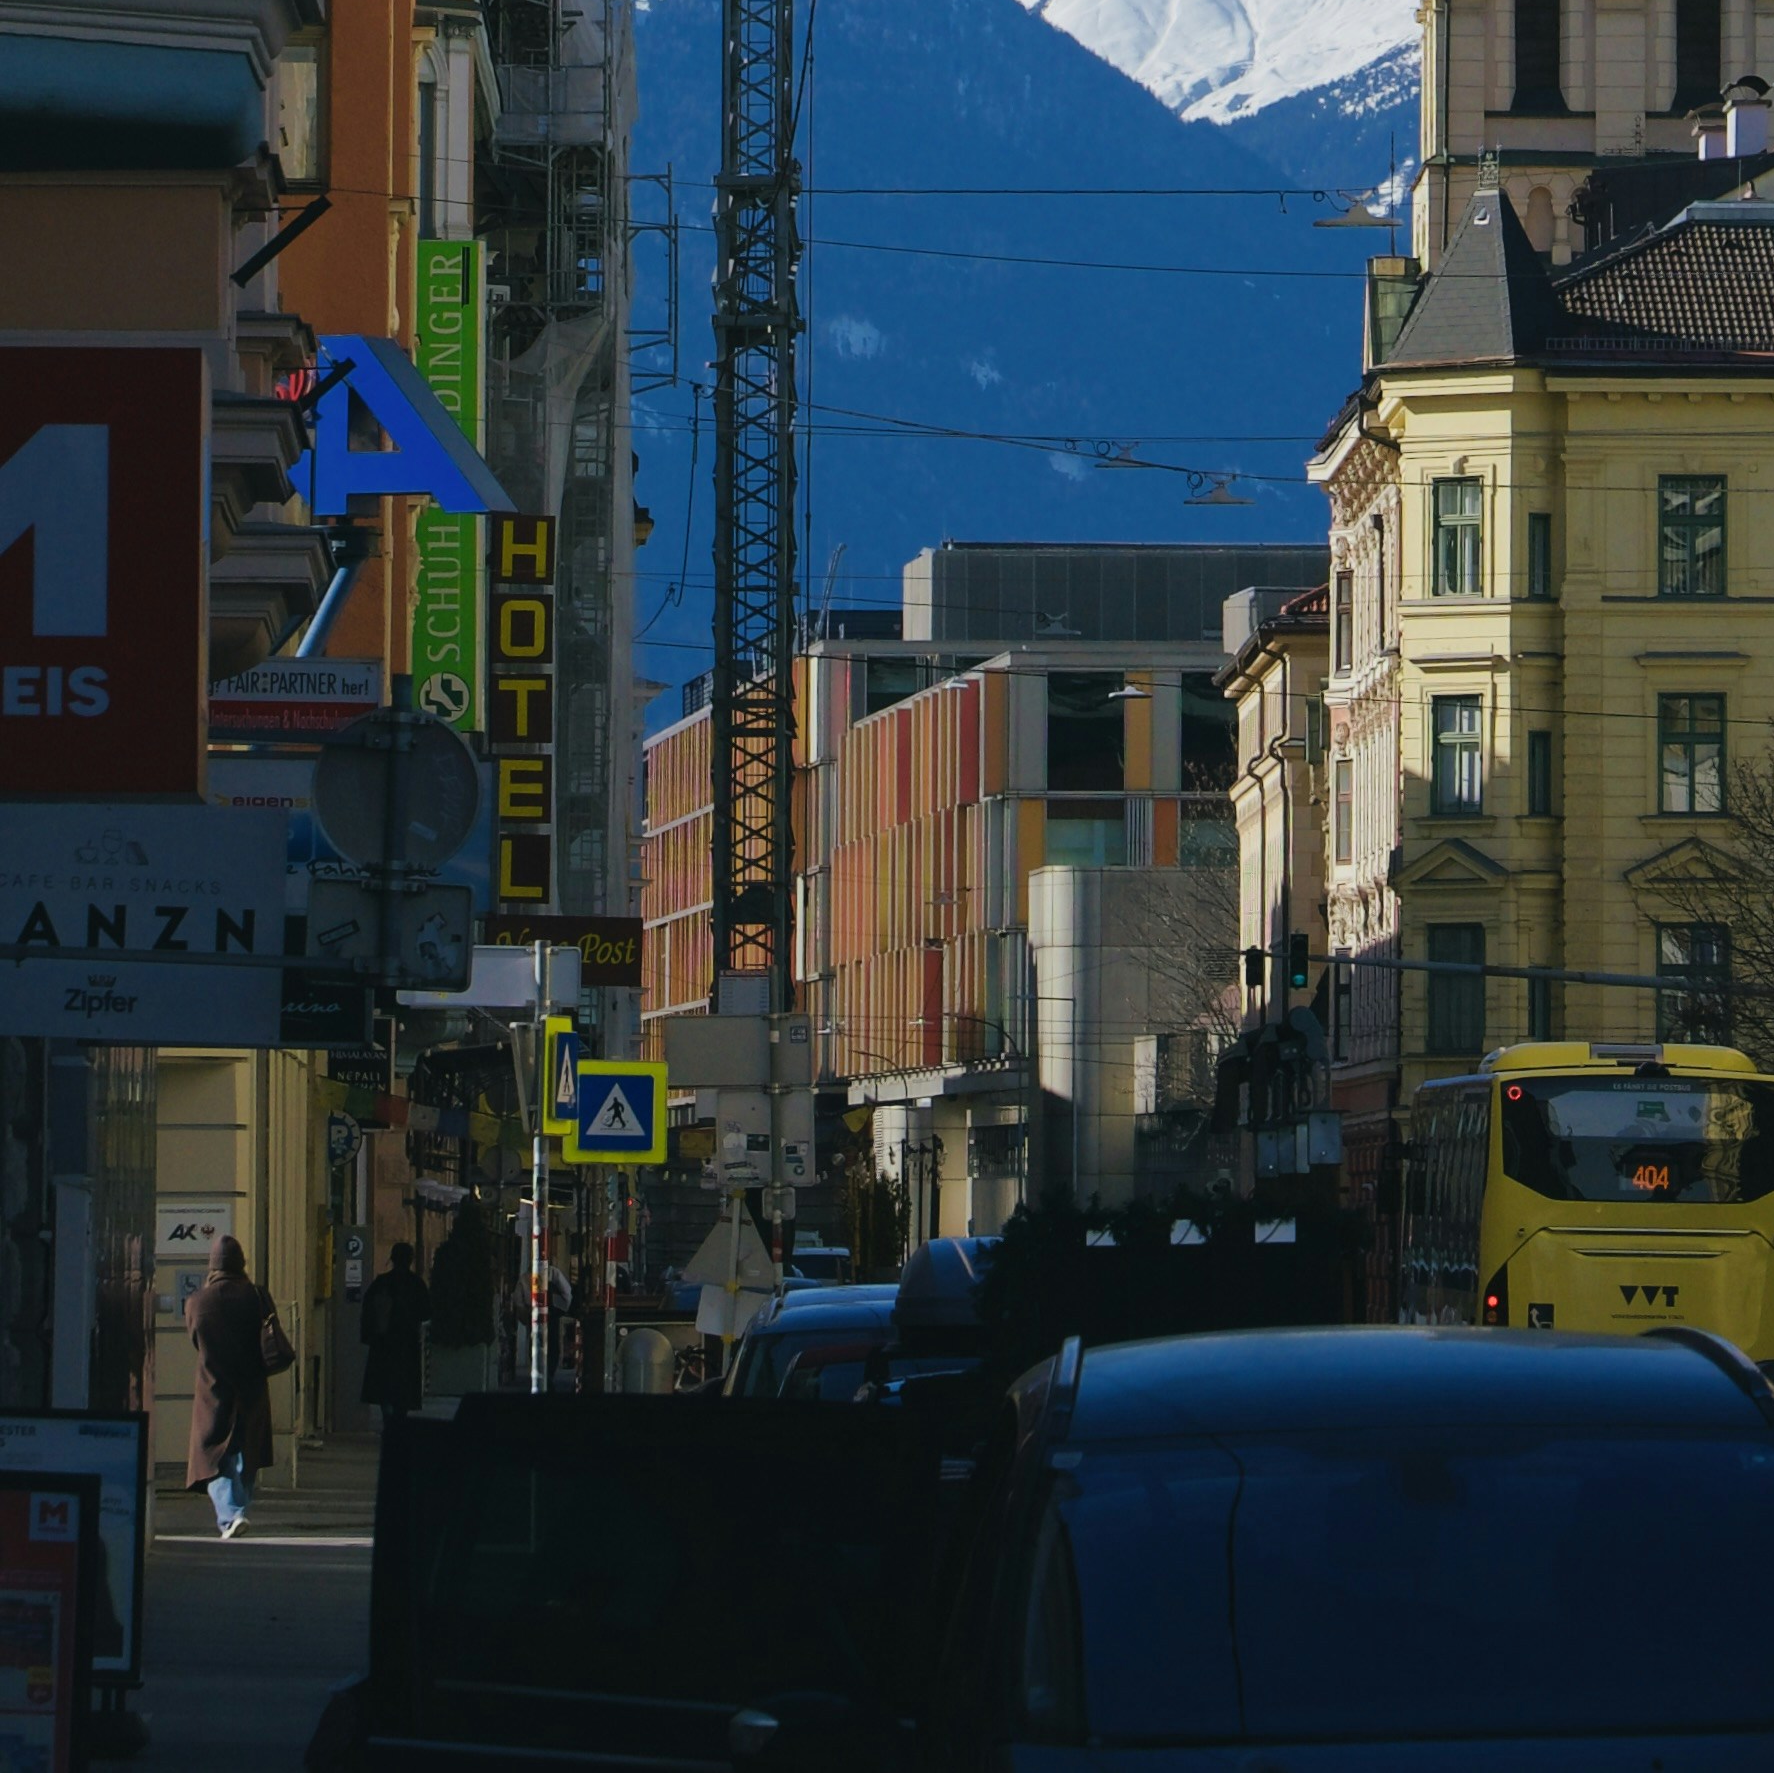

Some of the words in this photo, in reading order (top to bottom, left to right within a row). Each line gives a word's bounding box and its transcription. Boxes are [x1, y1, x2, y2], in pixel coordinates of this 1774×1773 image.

[426, 524, 461, 663] SCHUH
[341, 678, 369, 695] her!
[498, 520, 549, 898] HOTEL
[70, 876, 113, 891] BAR
[129, 878, 222, 896] SNACKS
[577, 933, 636, 965] Post
[64, 988, 138, 1019] Zipfer
[336, 1070, 381, 1082] NEPALI
[1632, 1163, 1670, 1191] 404
[167, 1223, 198, 1241] AK
[1619, 1285, 1679, 1307] VVT
